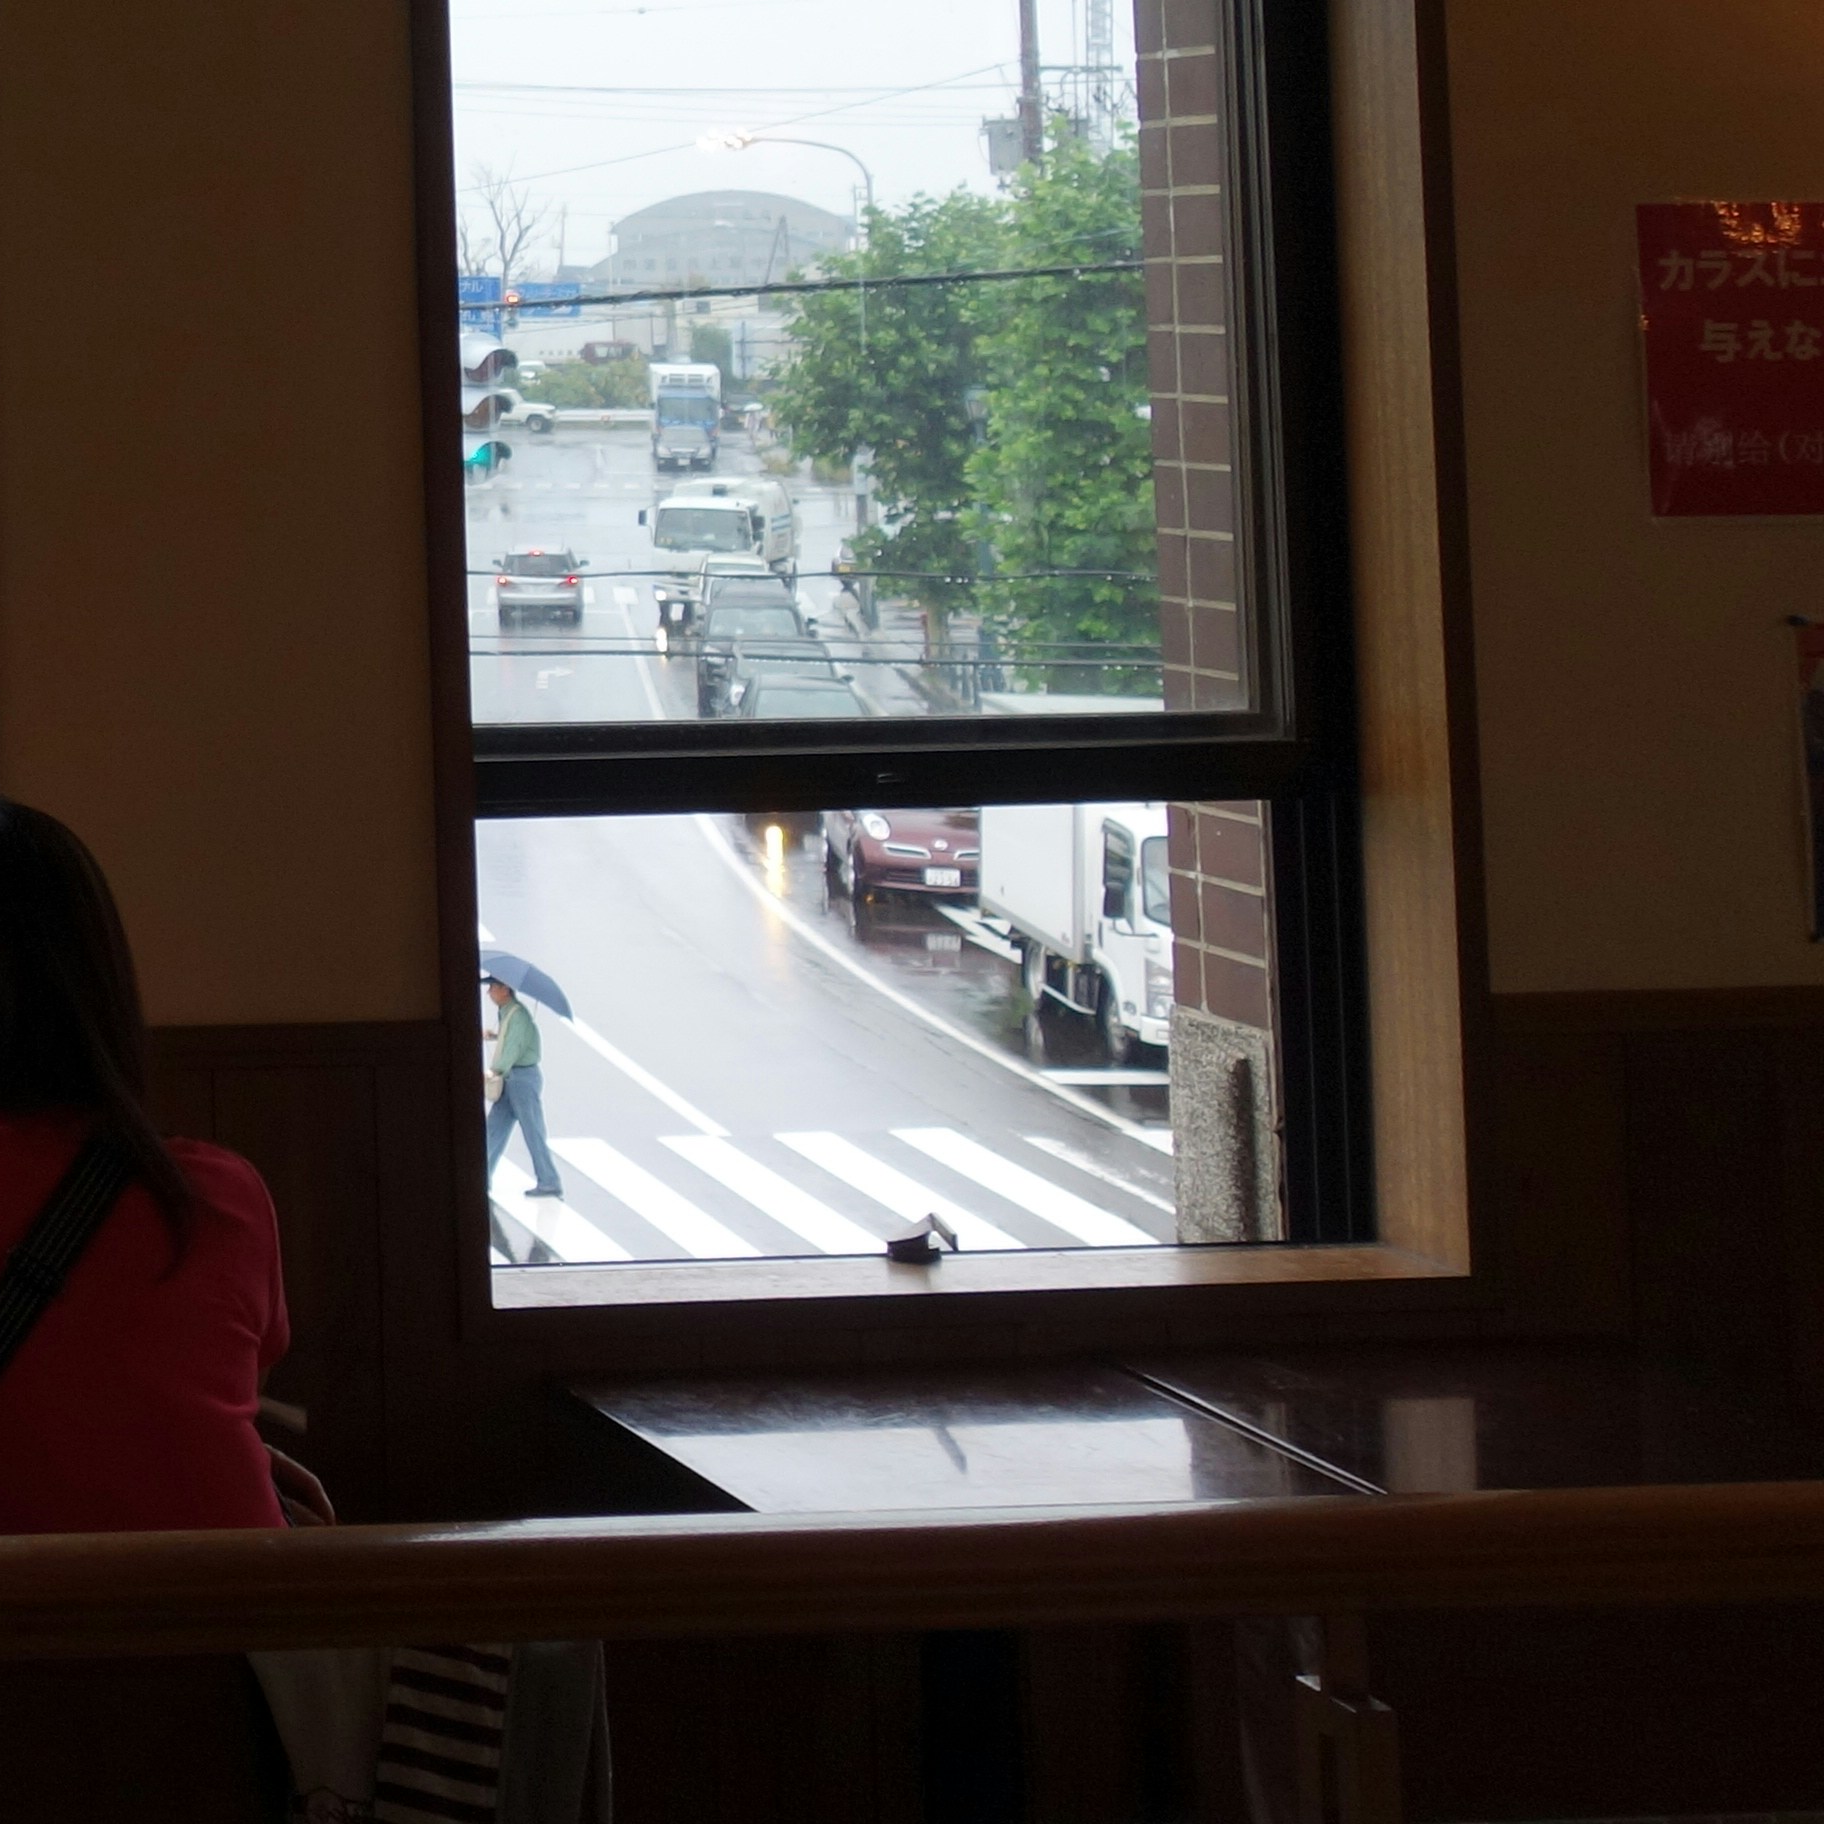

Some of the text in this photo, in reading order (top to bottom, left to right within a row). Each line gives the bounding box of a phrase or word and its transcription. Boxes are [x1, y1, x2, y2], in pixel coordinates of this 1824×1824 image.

[1658, 249, 1824, 292] カラスに
[1700, 318, 1822, 363] 与えな
